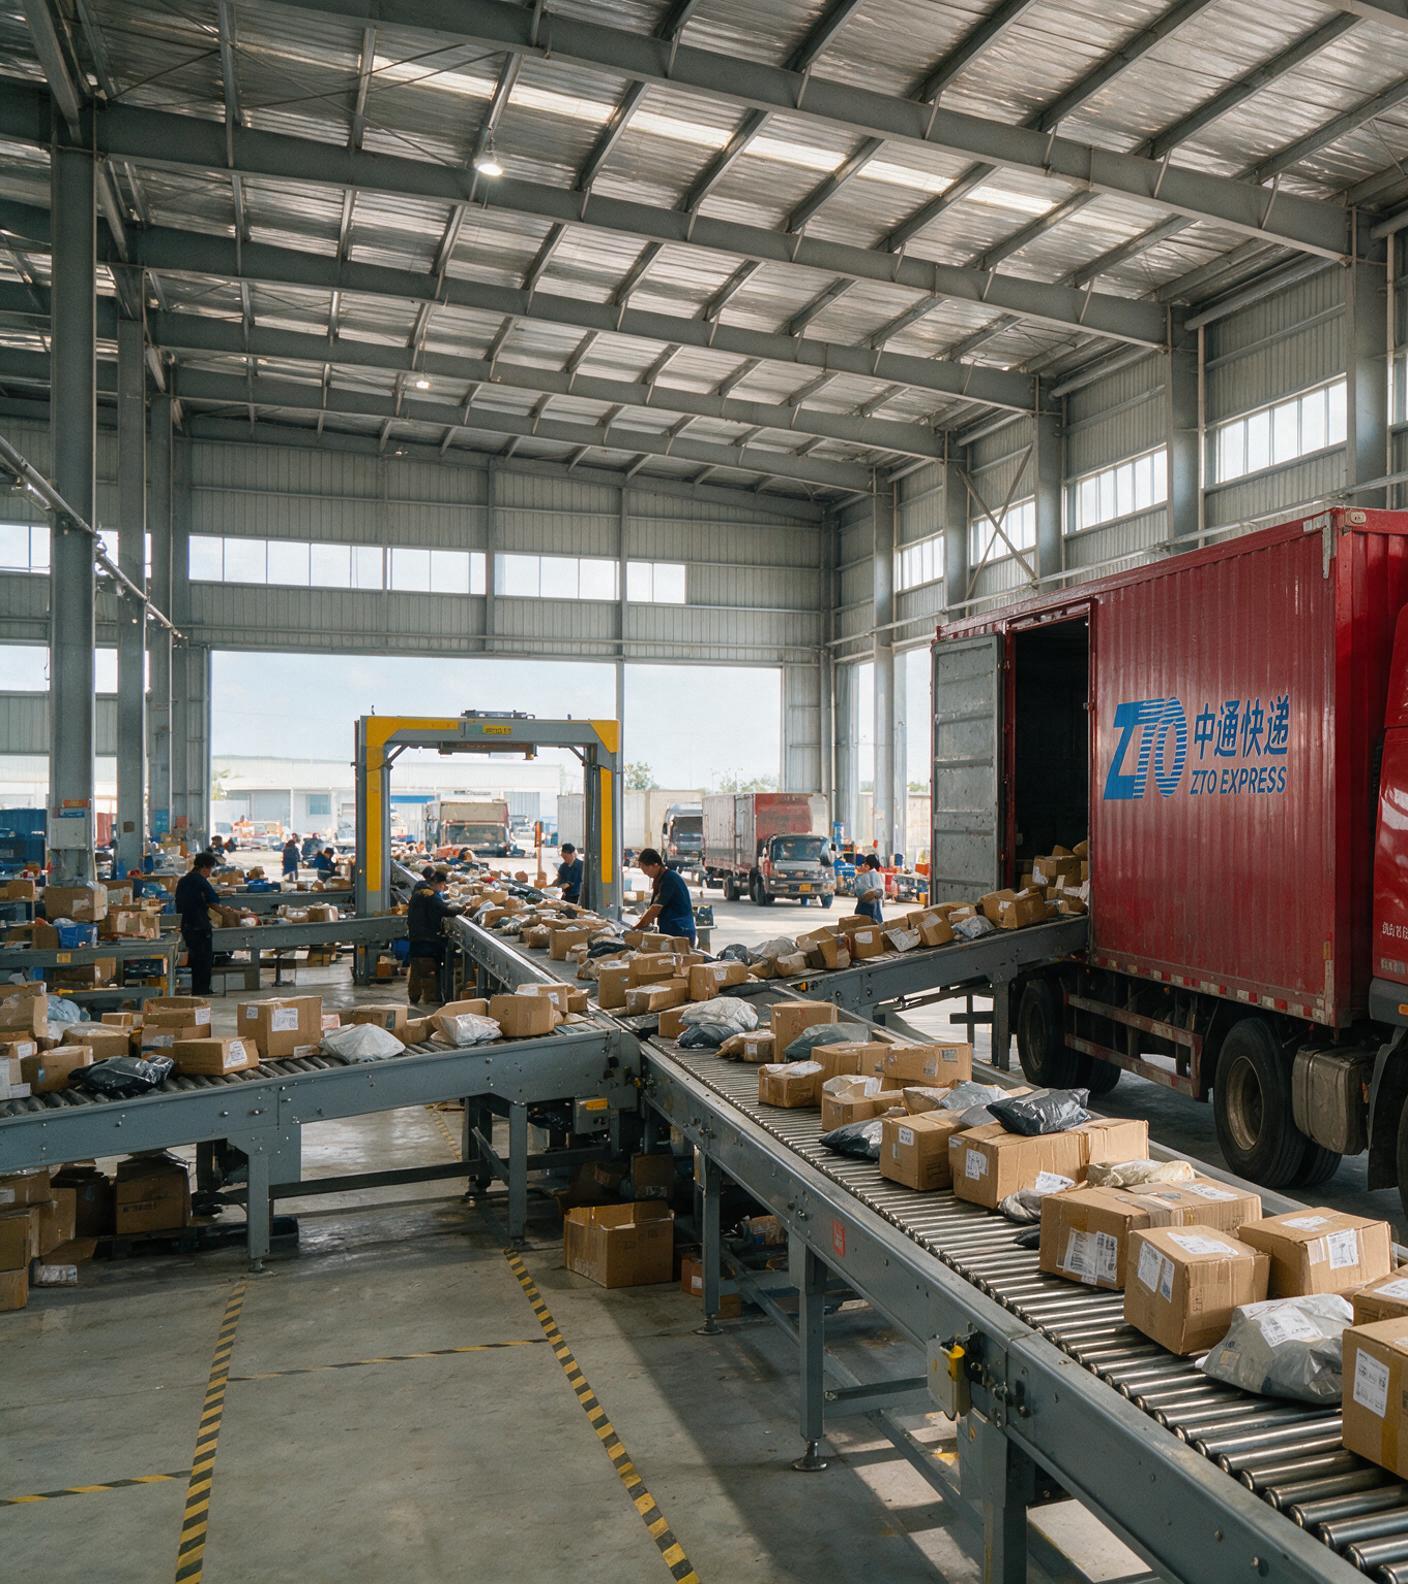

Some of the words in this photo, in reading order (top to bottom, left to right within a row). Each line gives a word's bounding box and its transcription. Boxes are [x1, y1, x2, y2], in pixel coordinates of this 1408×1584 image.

[1103, 696, 1188, 800] ZTO
[1194, 695, 1289, 760] 中通快递
[1190, 769, 1218, 795] ZTO
[1219, 766, 1287, 795] EXPRESS
